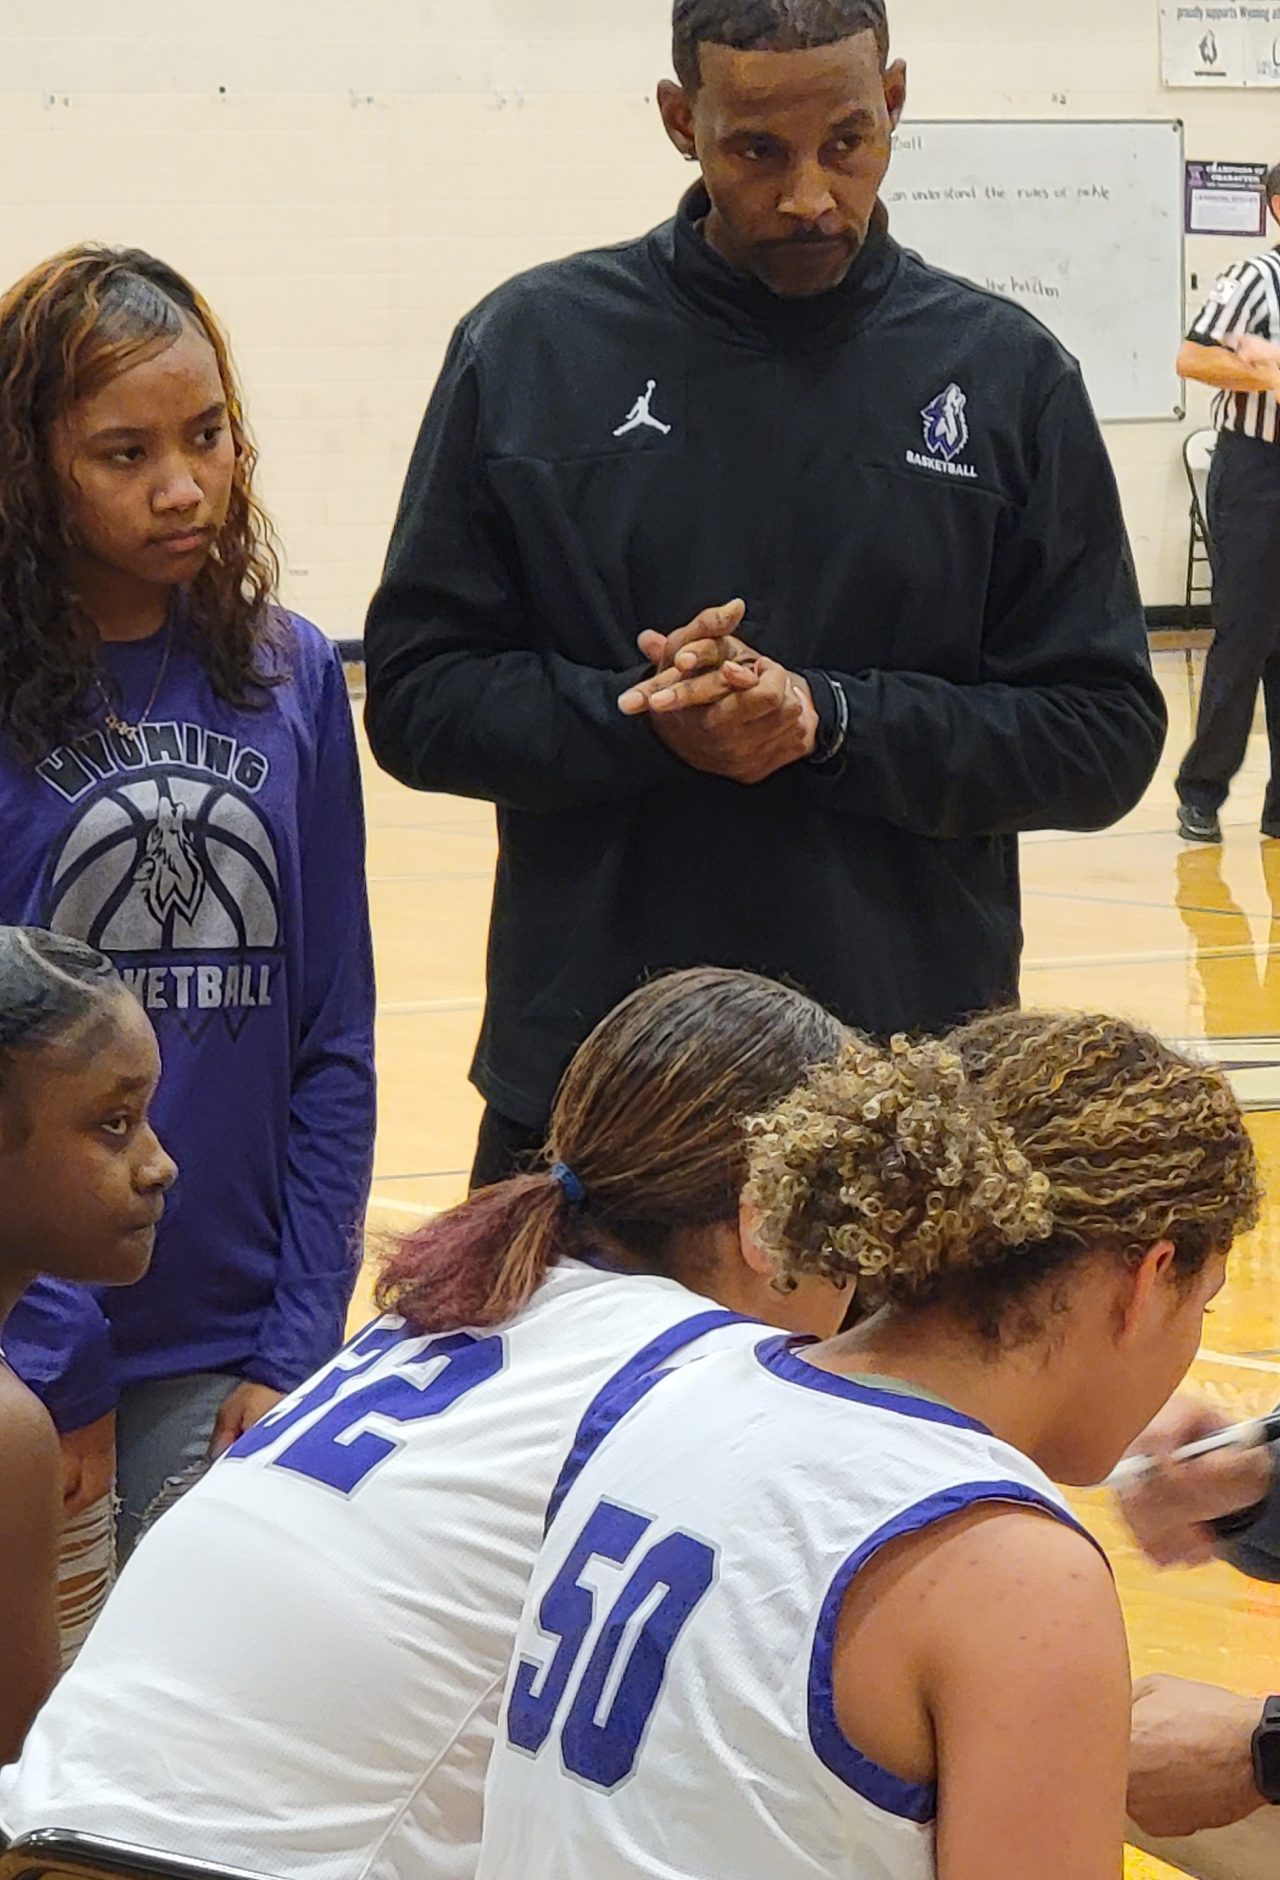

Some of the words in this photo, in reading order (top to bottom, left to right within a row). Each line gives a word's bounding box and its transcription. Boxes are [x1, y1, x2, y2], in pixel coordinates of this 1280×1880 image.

[906, 450, 977, 477] BASKETBALL
[35, 721, 270, 802] WYOMING
[121, 964, 272, 1009] KETBALL
[506, 1494, 721, 1796] 50
